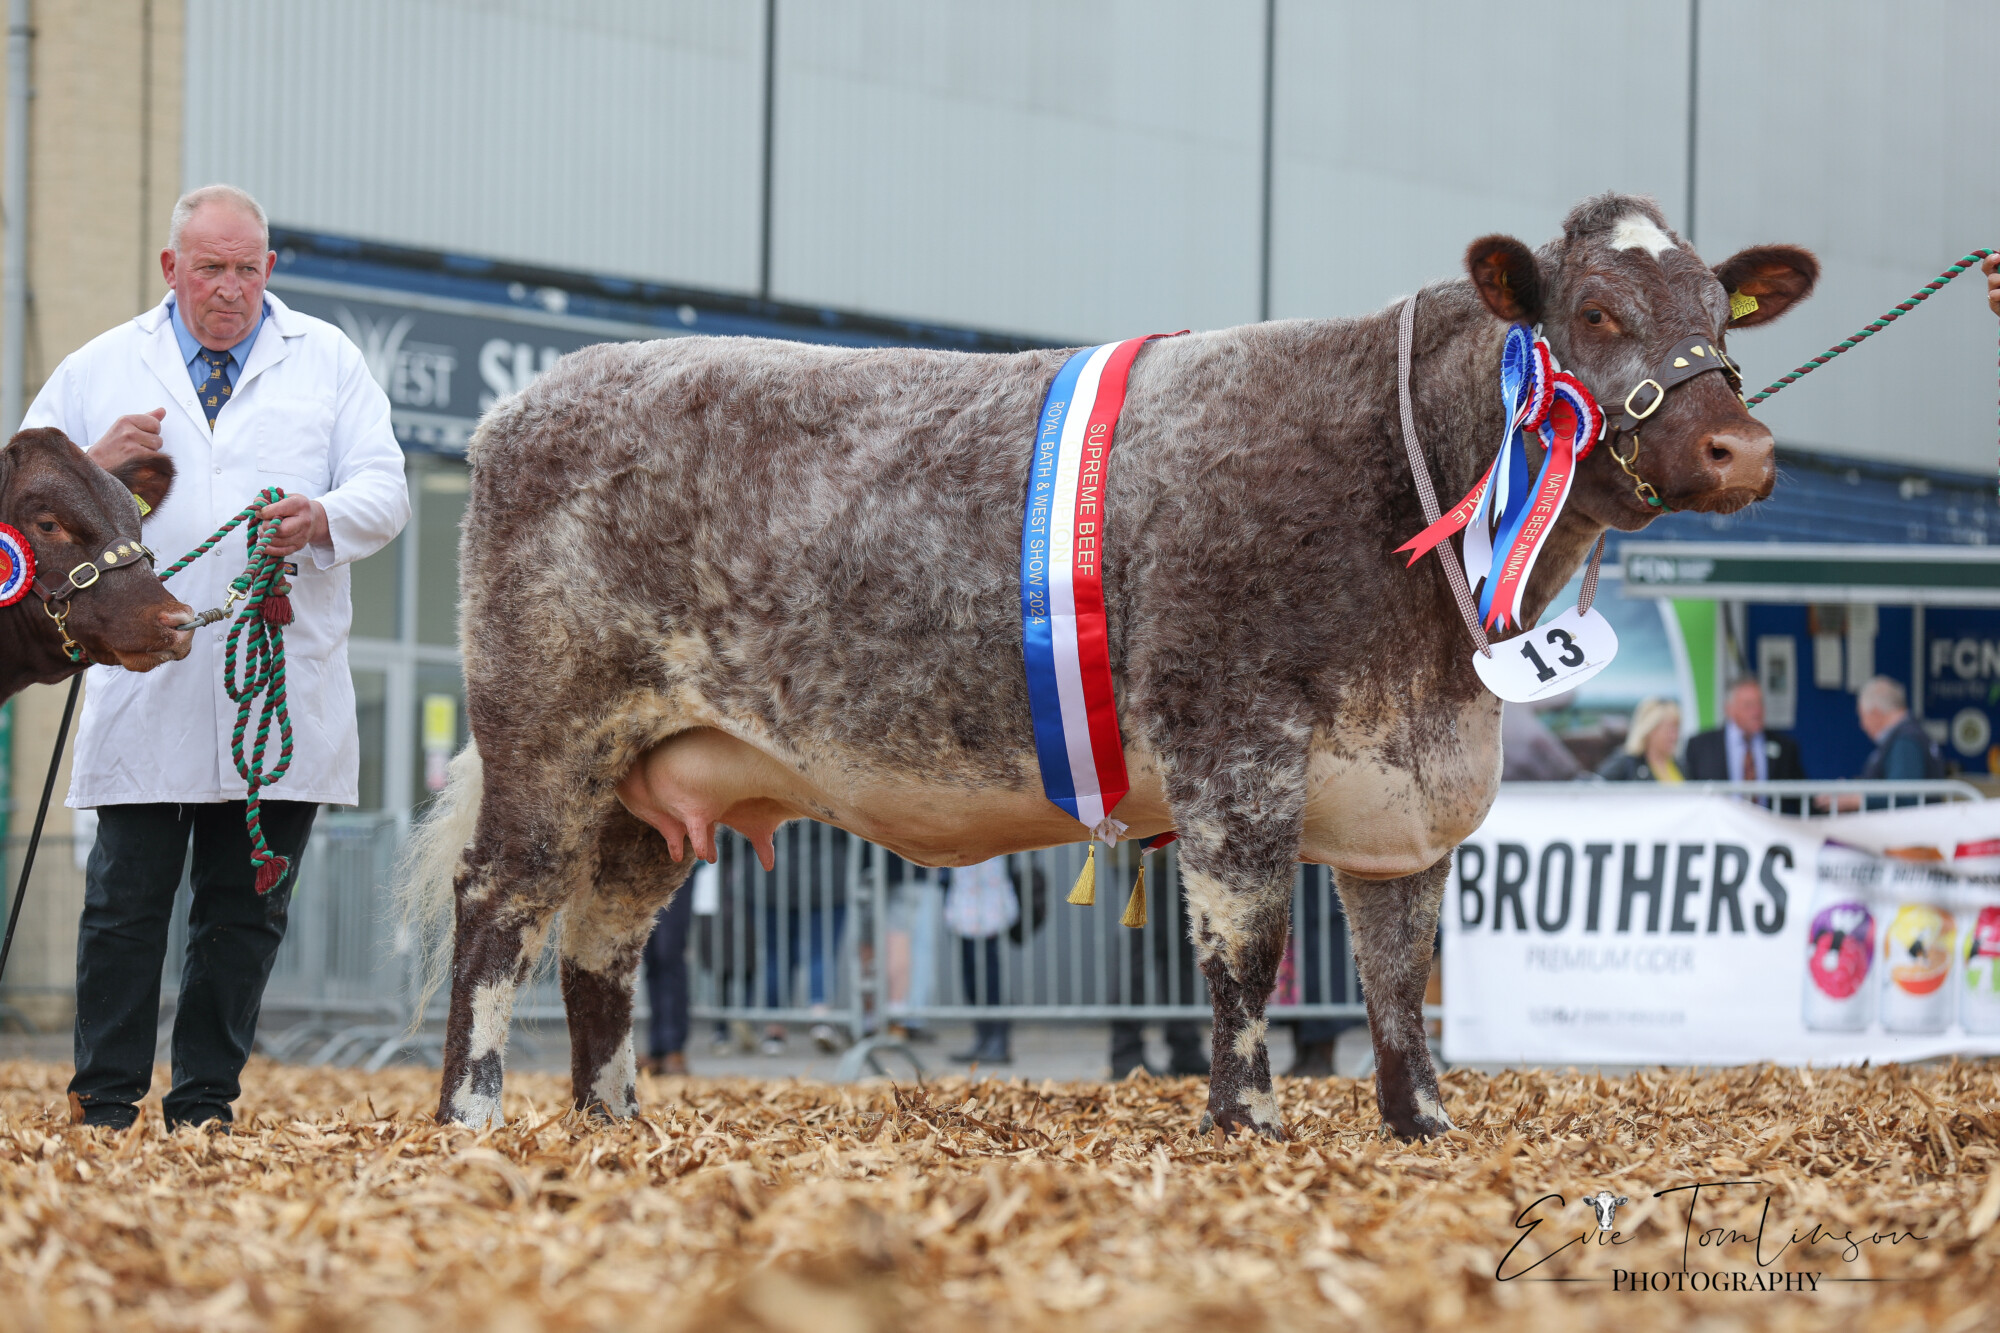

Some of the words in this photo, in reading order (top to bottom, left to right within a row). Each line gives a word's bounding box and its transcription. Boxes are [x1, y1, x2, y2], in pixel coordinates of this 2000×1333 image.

[1042, 402, 1065, 439] ROYAL
[1037, 442, 1055, 477] BATH
[1080, 424, 1107, 516] SUPREME
[1036, 482, 1050, 492] &
[1052, 440, 1080, 563] CHAMPION
[1536, 473, 1564, 513] NATIVE
[1031, 494, 1049, 535] WEST
[1522, 515, 1547, 542] BEEF
[1029, 539, 1045, 586] SHOW
[1077, 522, 1095, 576] BEEF
[1502, 542, 1530, 584] ANIMAL
[1029, 590, 1046, 625] 2024
[1520, 628, 1585, 683] 13
[1457, 842, 1794, 934] BROTHERS
